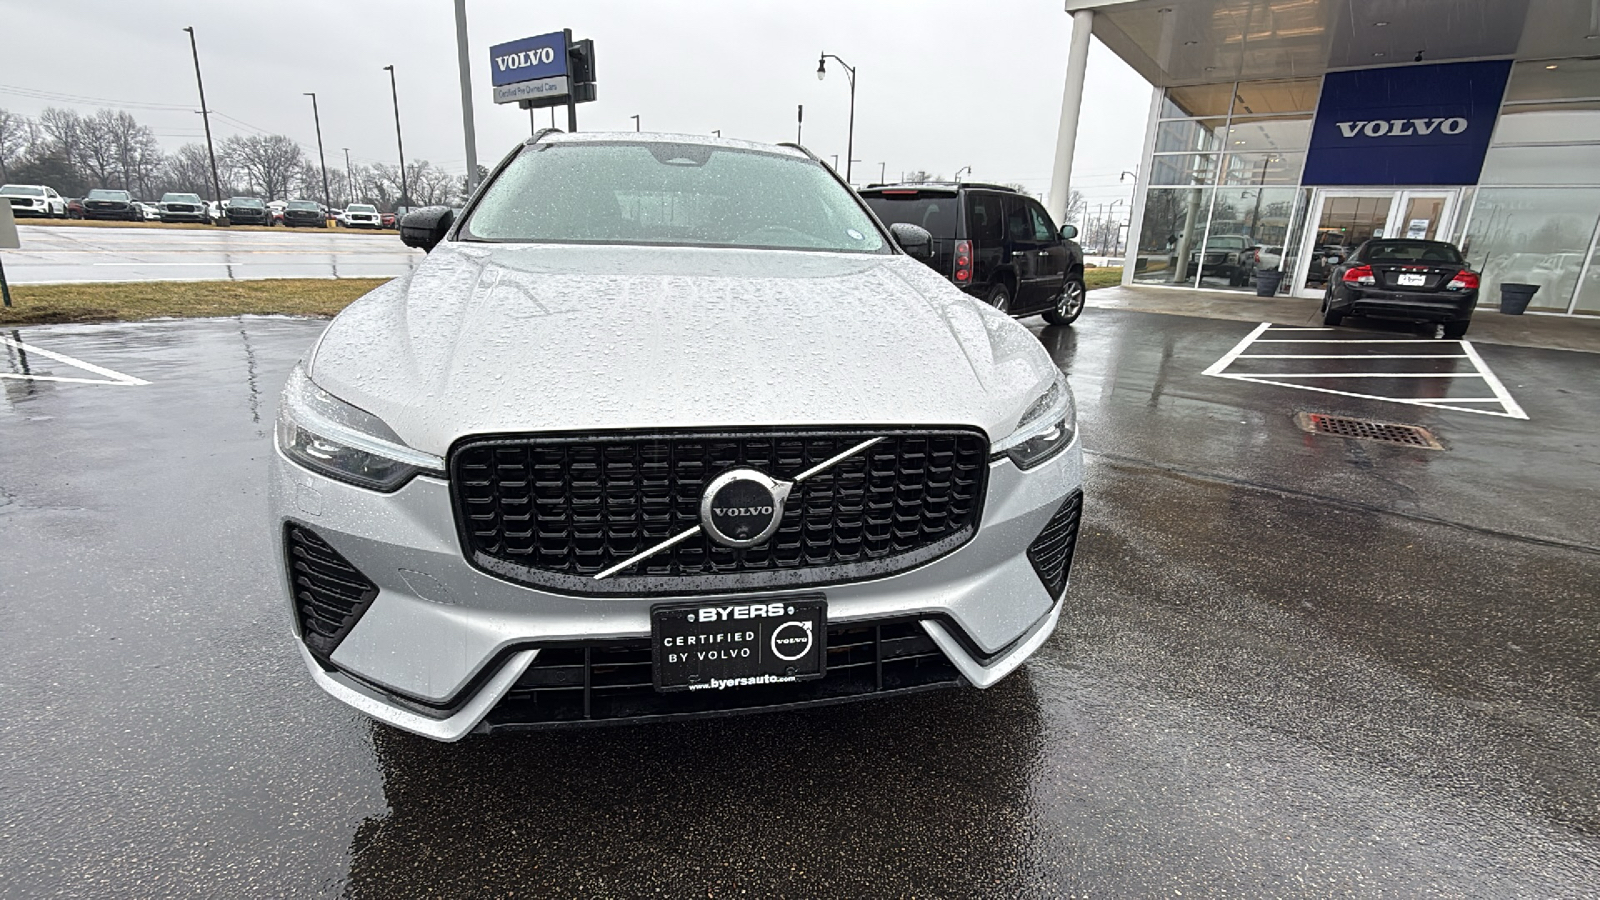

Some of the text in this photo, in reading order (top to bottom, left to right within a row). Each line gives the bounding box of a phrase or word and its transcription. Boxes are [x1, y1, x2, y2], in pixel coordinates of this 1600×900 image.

[495, 47, 554, 71] VOLVO
[526, 83, 543, 93] Owned
[1336, 117, 1468, 138] VOLVO
[713, 506, 772, 516] VOLVO
[699, 603, 784, 622] BYERS
[664, 631, 755, 647] CERTIFIED
[668, 647, 751, 663] BY VOLVO
[689, 674, 796, 691] www.byersauto.com
